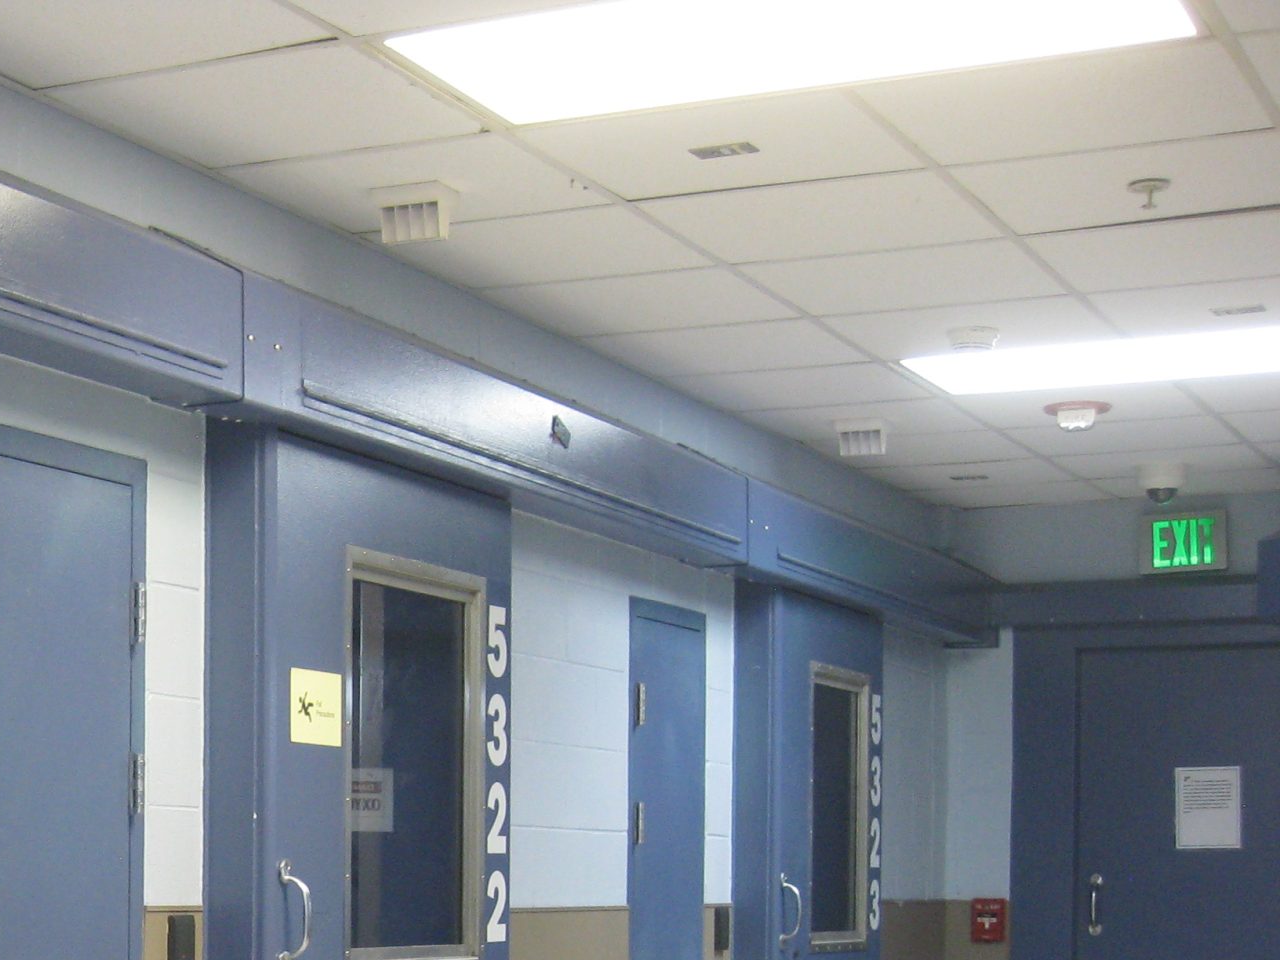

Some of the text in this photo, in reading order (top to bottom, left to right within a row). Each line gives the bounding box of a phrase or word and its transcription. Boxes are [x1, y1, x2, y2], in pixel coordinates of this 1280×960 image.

[1152, 518, 1215, 568] EXIT
[487, 605, 507, 942] 5322
[870, 694, 882, 930] 5323
